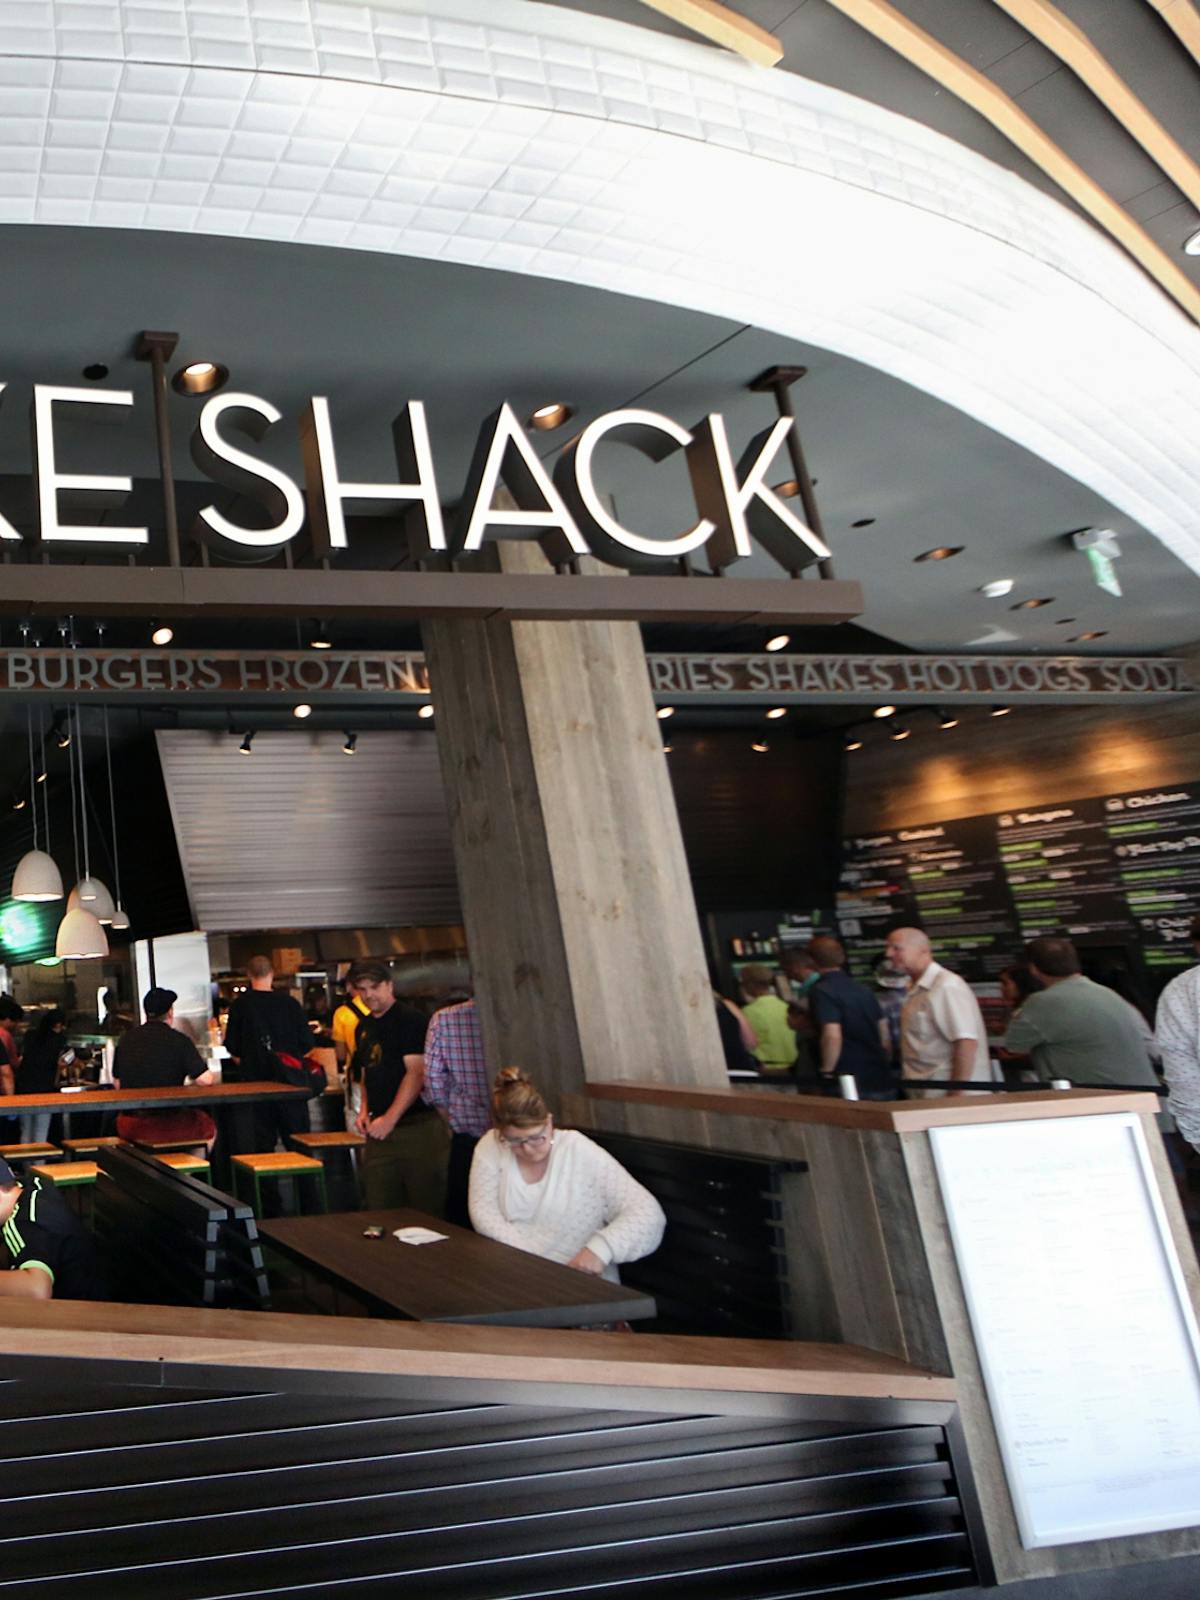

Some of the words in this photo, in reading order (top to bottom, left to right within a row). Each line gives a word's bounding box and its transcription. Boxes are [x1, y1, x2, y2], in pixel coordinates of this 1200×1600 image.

[198, 391, 832, 560] SHACK
[7, 652, 220, 690] BURGERS
[238, 655, 417, 691] FROZEN
[651, 658, 735, 692] RIES
[746, 657, 893, 692] SHAKES
[905, 660, 986, 692] HOT
[990, 660, 1091, 692] DOGS
